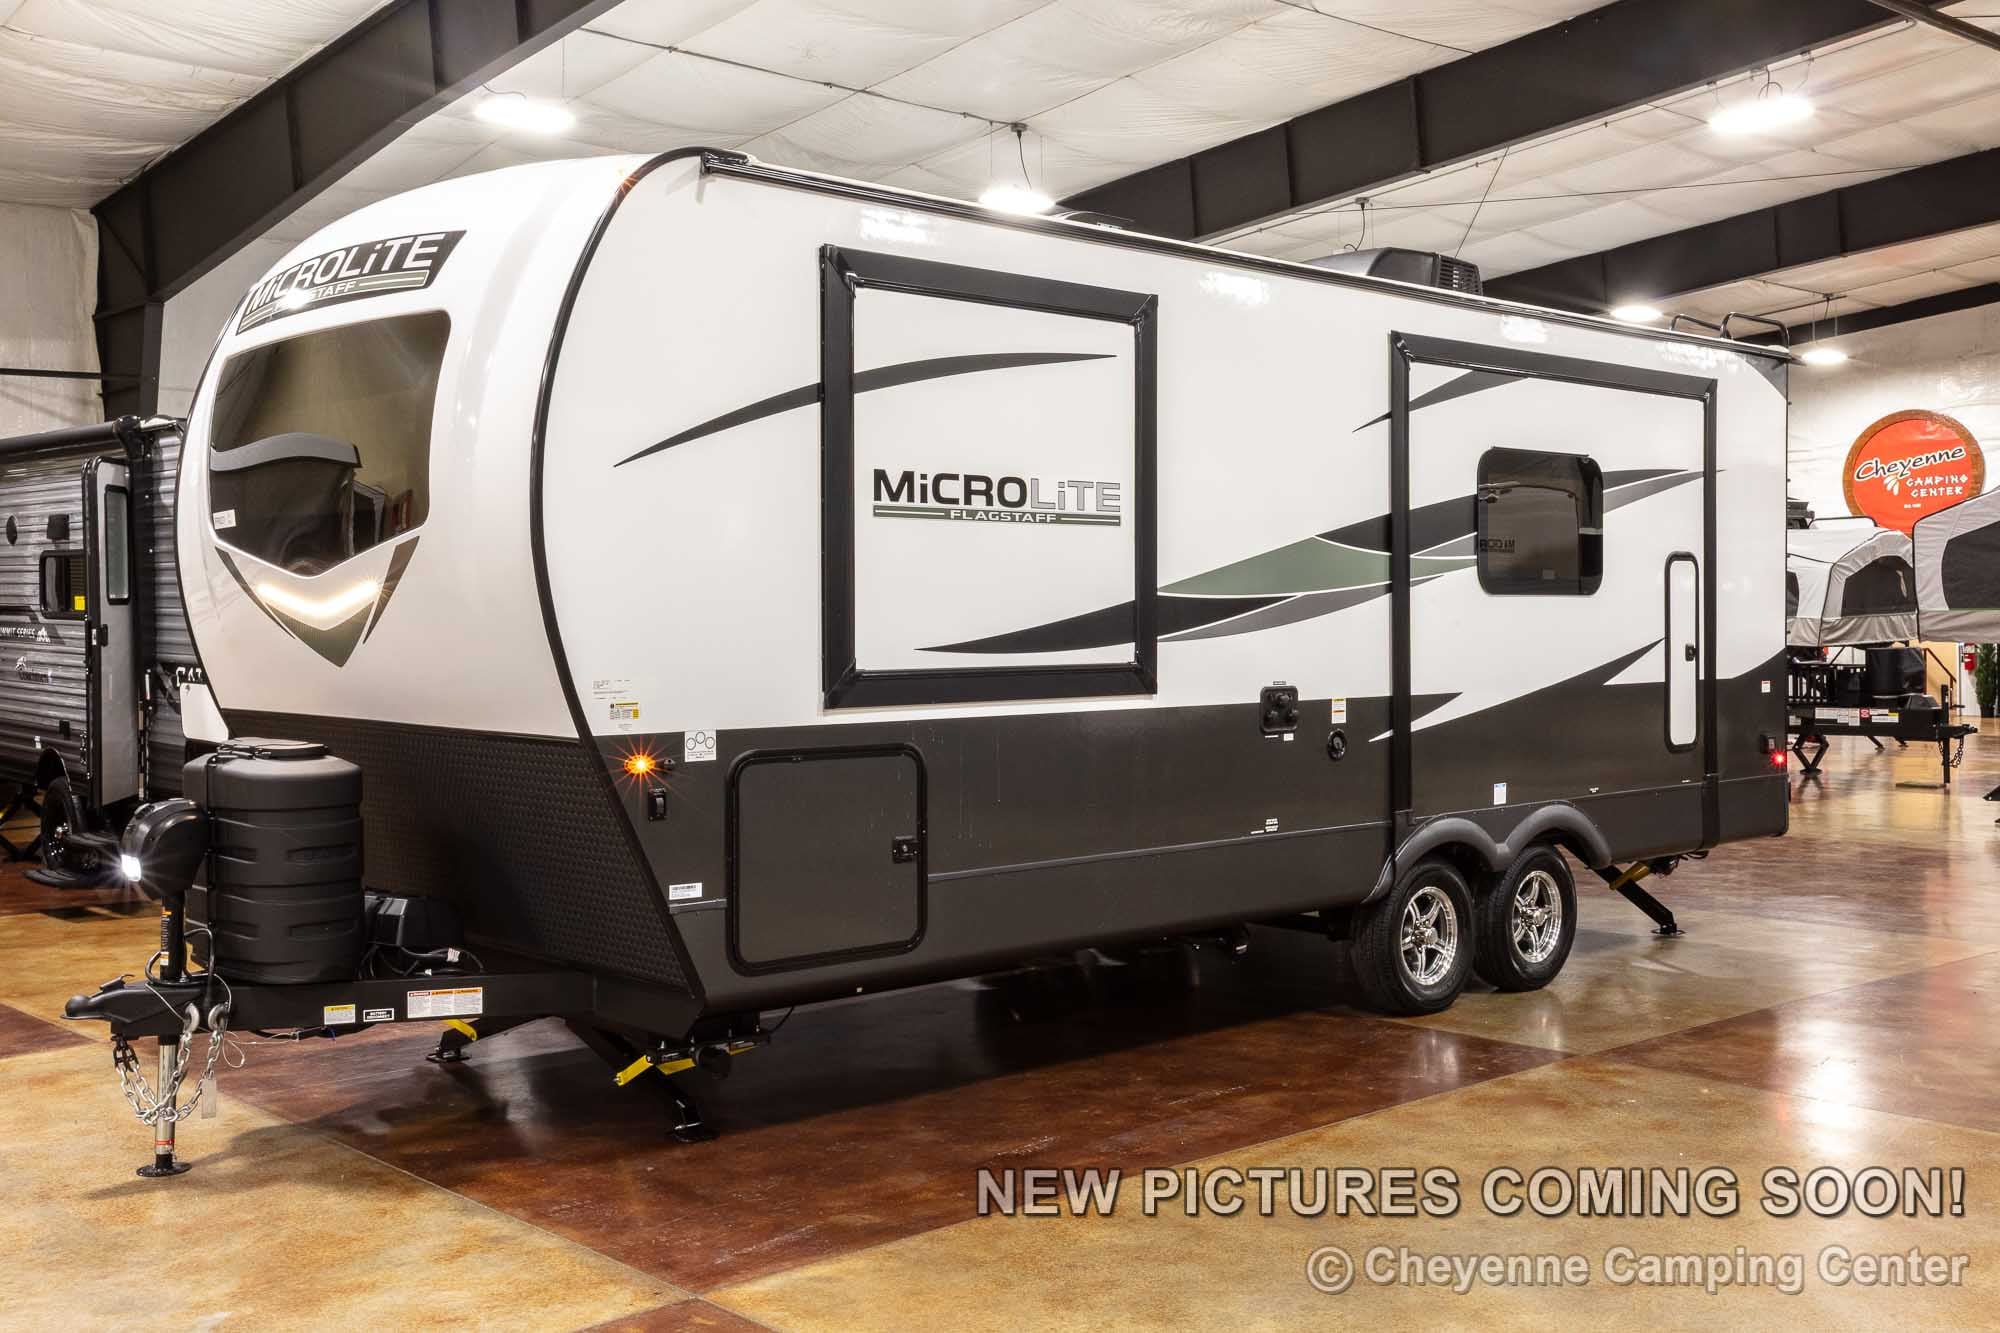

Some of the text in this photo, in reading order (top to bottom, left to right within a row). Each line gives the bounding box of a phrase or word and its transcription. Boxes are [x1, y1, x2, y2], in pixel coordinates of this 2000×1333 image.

[1855, 447, 1966, 480] Cheyenne
[1905, 474, 1969, 487] CAMPING
[1910, 486, 1963, 498] CENTER
[950, 509, 1057, 524] FLAGSTAFF
